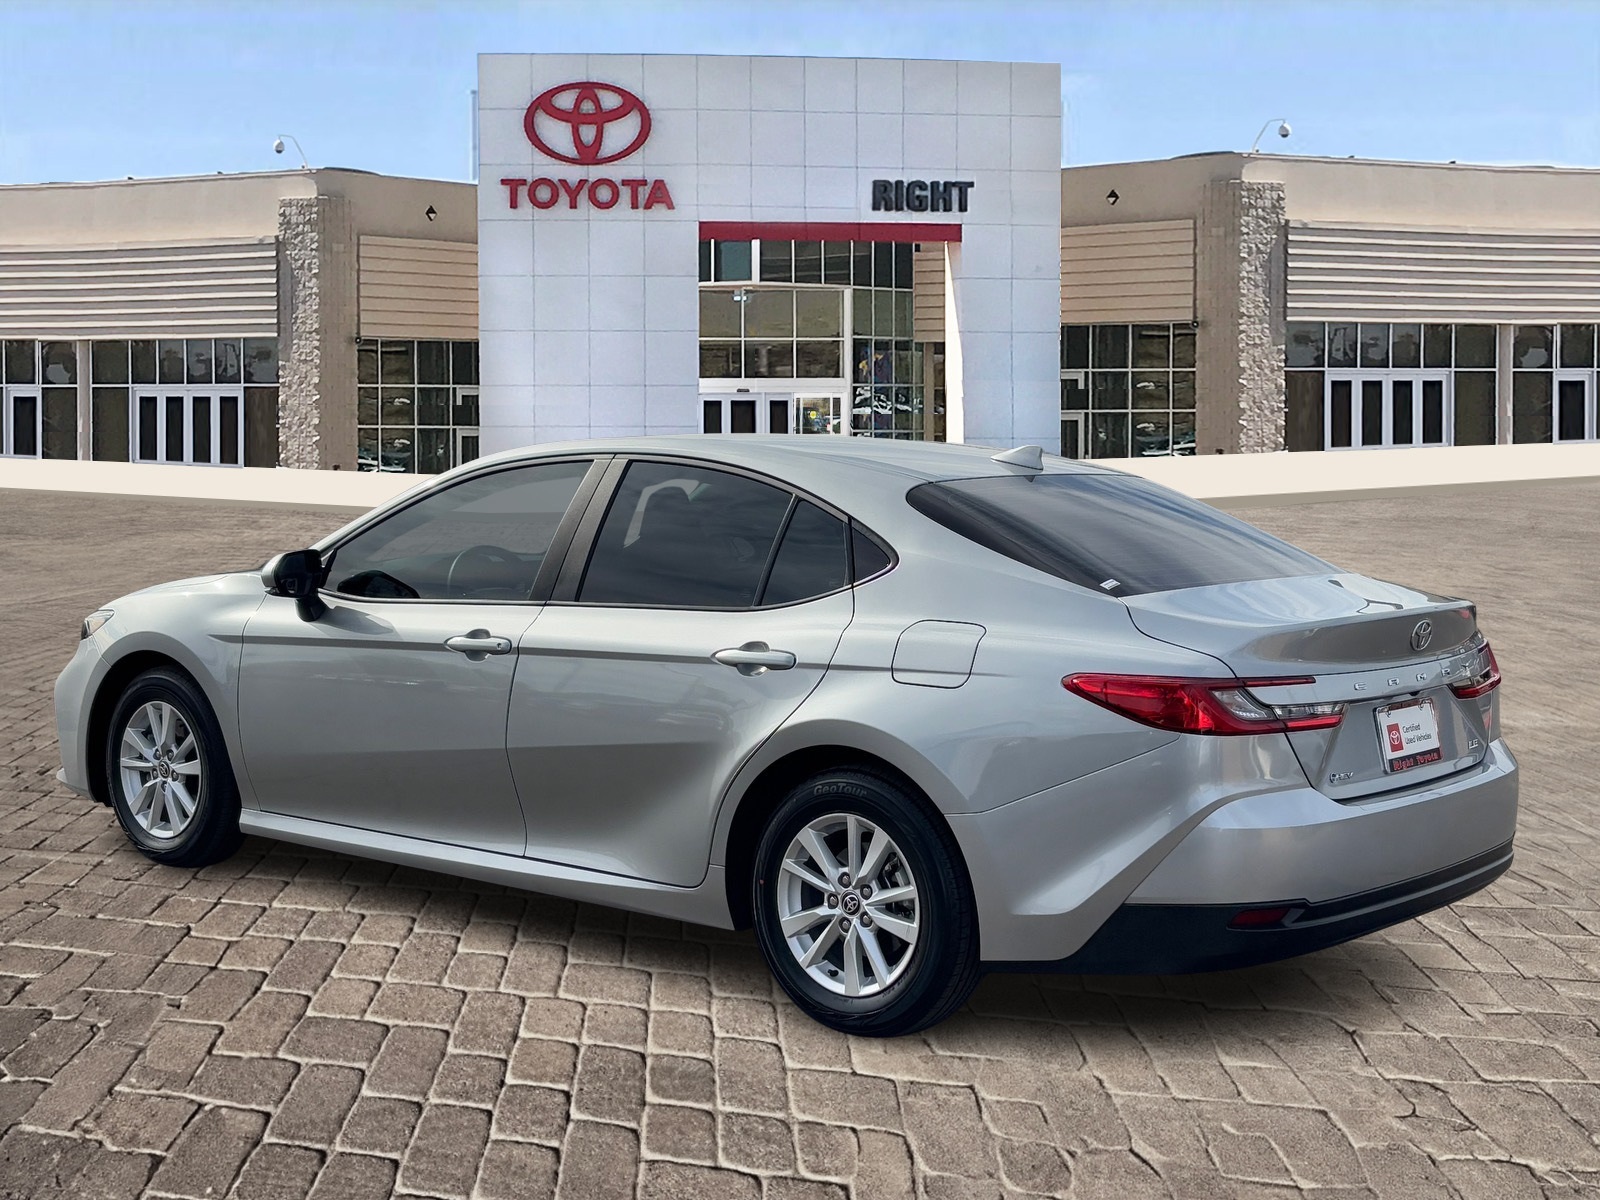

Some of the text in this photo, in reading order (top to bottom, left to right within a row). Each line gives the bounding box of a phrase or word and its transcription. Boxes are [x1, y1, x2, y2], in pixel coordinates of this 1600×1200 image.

[500, 177, 676, 210] TOYOTA
[872, 179, 975, 212] RIGHT
[1402, 723, 1421, 734] Certified
[1405, 732, 1432, 745] Used Vehicles
[1393, 752, 1438, 771] Right Toyota
[813, 782, 868, 797] GeoTour
